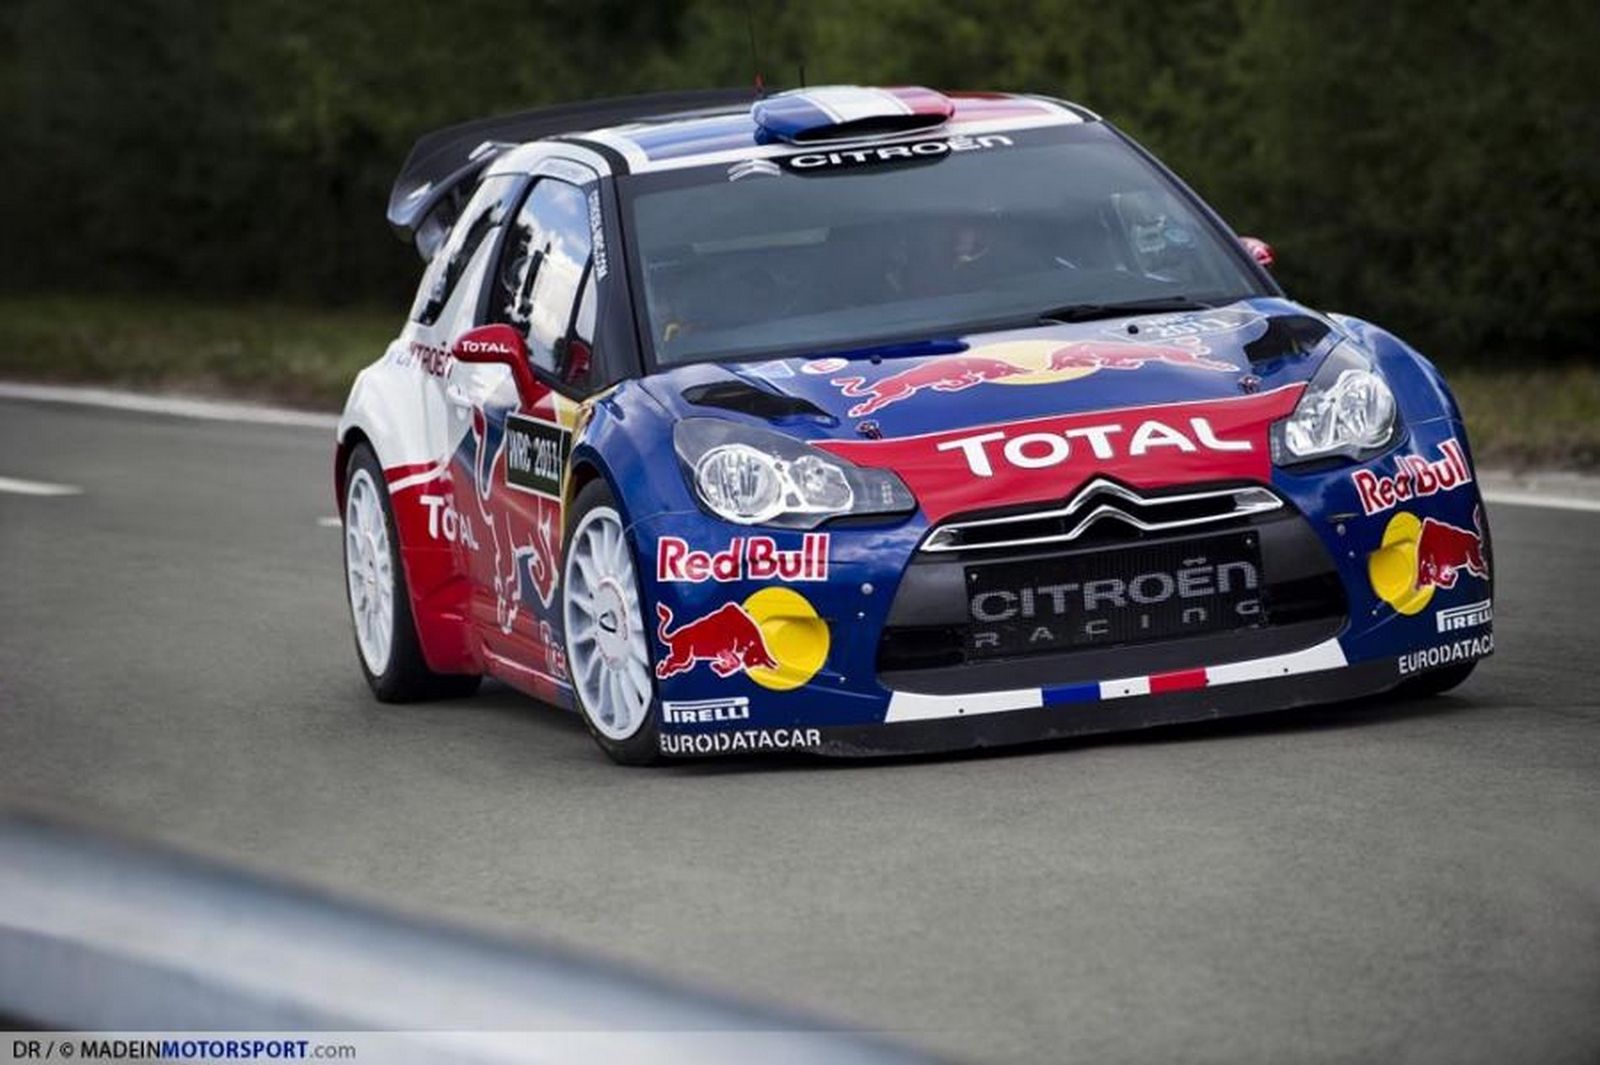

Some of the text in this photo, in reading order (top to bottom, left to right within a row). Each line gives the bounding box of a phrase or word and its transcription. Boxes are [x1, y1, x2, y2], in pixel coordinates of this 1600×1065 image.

[462, 341, 511, 353] TOTAL
[508, 429, 559, 482] WRC 2011
[937, 418, 1253, 477] TOTAL
[1351, 438, 1472, 516] Red Bull
[420, 495, 480, 551] TOTAL
[656, 533, 830, 582] Red Bull
[662, 697, 749, 723] PIRELLI
[659, 729, 821, 753] EURODATACAR
